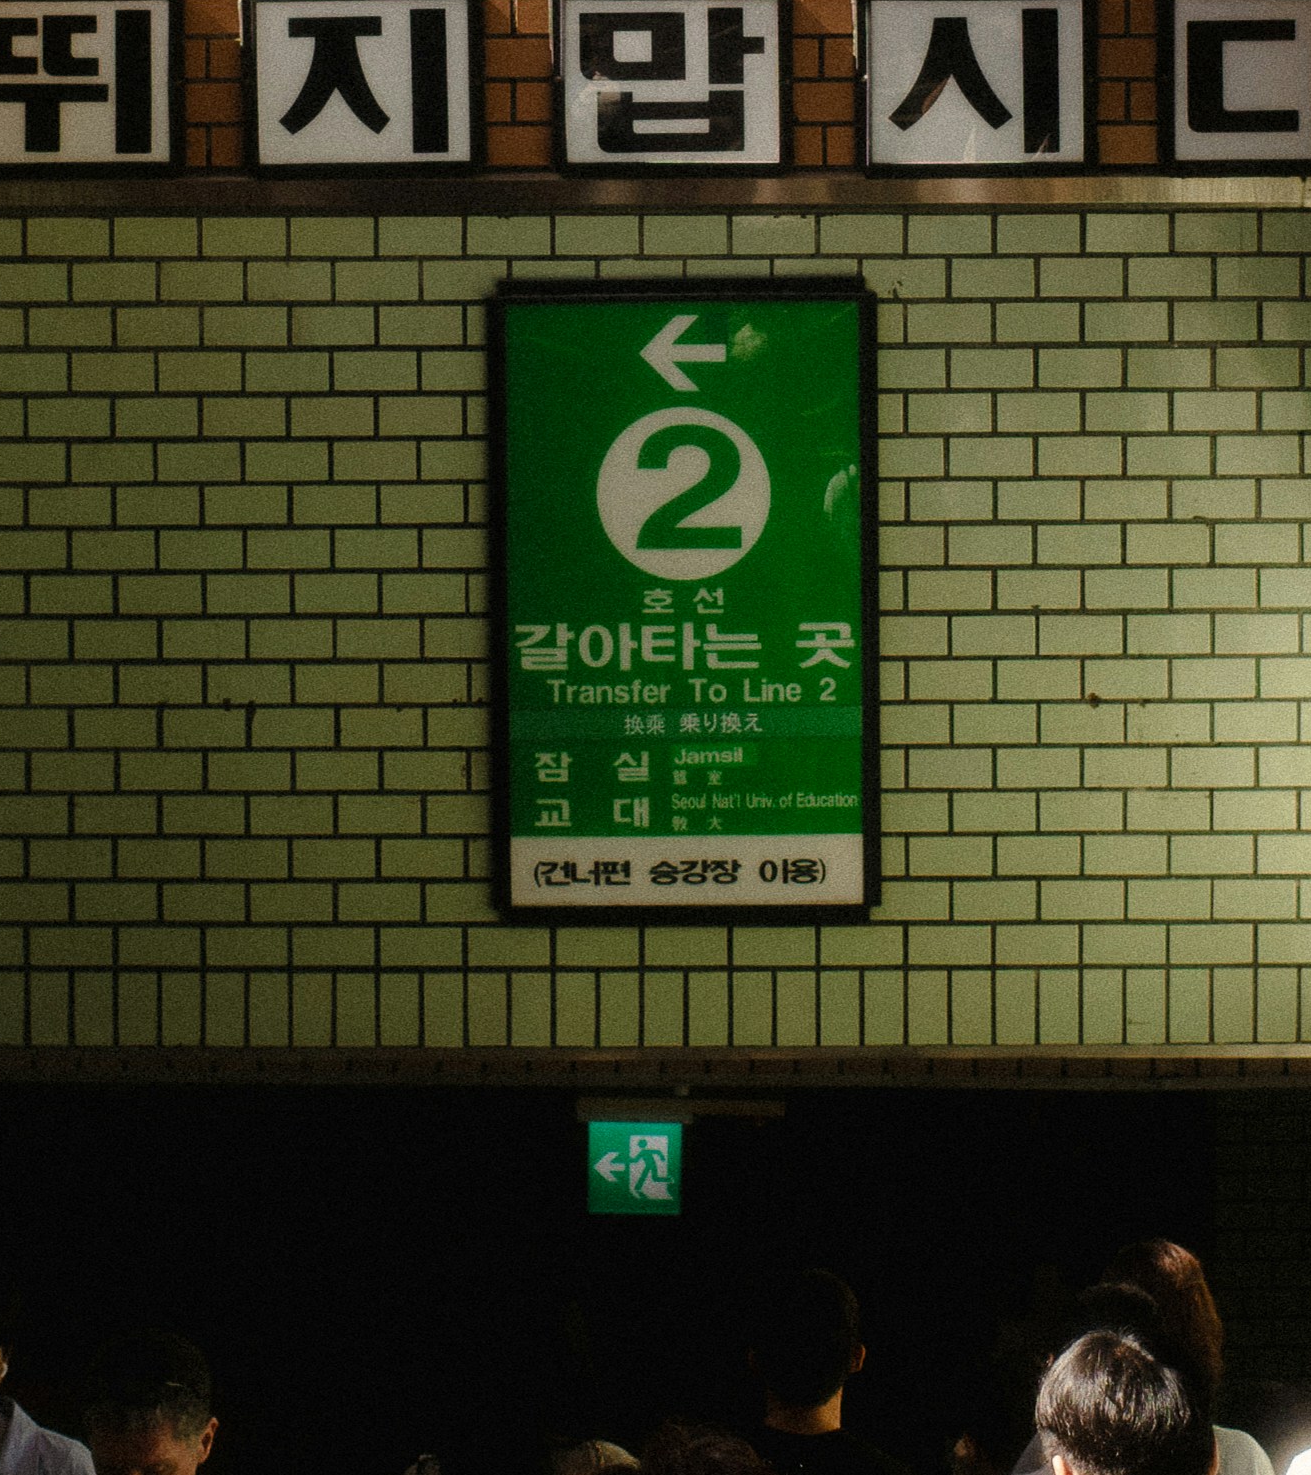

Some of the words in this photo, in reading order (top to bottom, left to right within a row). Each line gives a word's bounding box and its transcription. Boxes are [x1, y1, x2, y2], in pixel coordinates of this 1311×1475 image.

[635, 423, 742, 550] 2
[515, 622, 762, 671] 갈아타는
[795, 621, 855, 669] 곳
[546, 678, 671, 704] Transfer
[688, 678, 727, 704] To
[743, 678, 802, 702] Line
[819, 677, 837, 702] 2
[674, 747, 744, 765] Jamsil
[671, 793, 706, 810] Seoul
[779, 793, 793, 808] of
[796, 791, 858, 808] Education
[649, 858, 743, 886] 승강장
